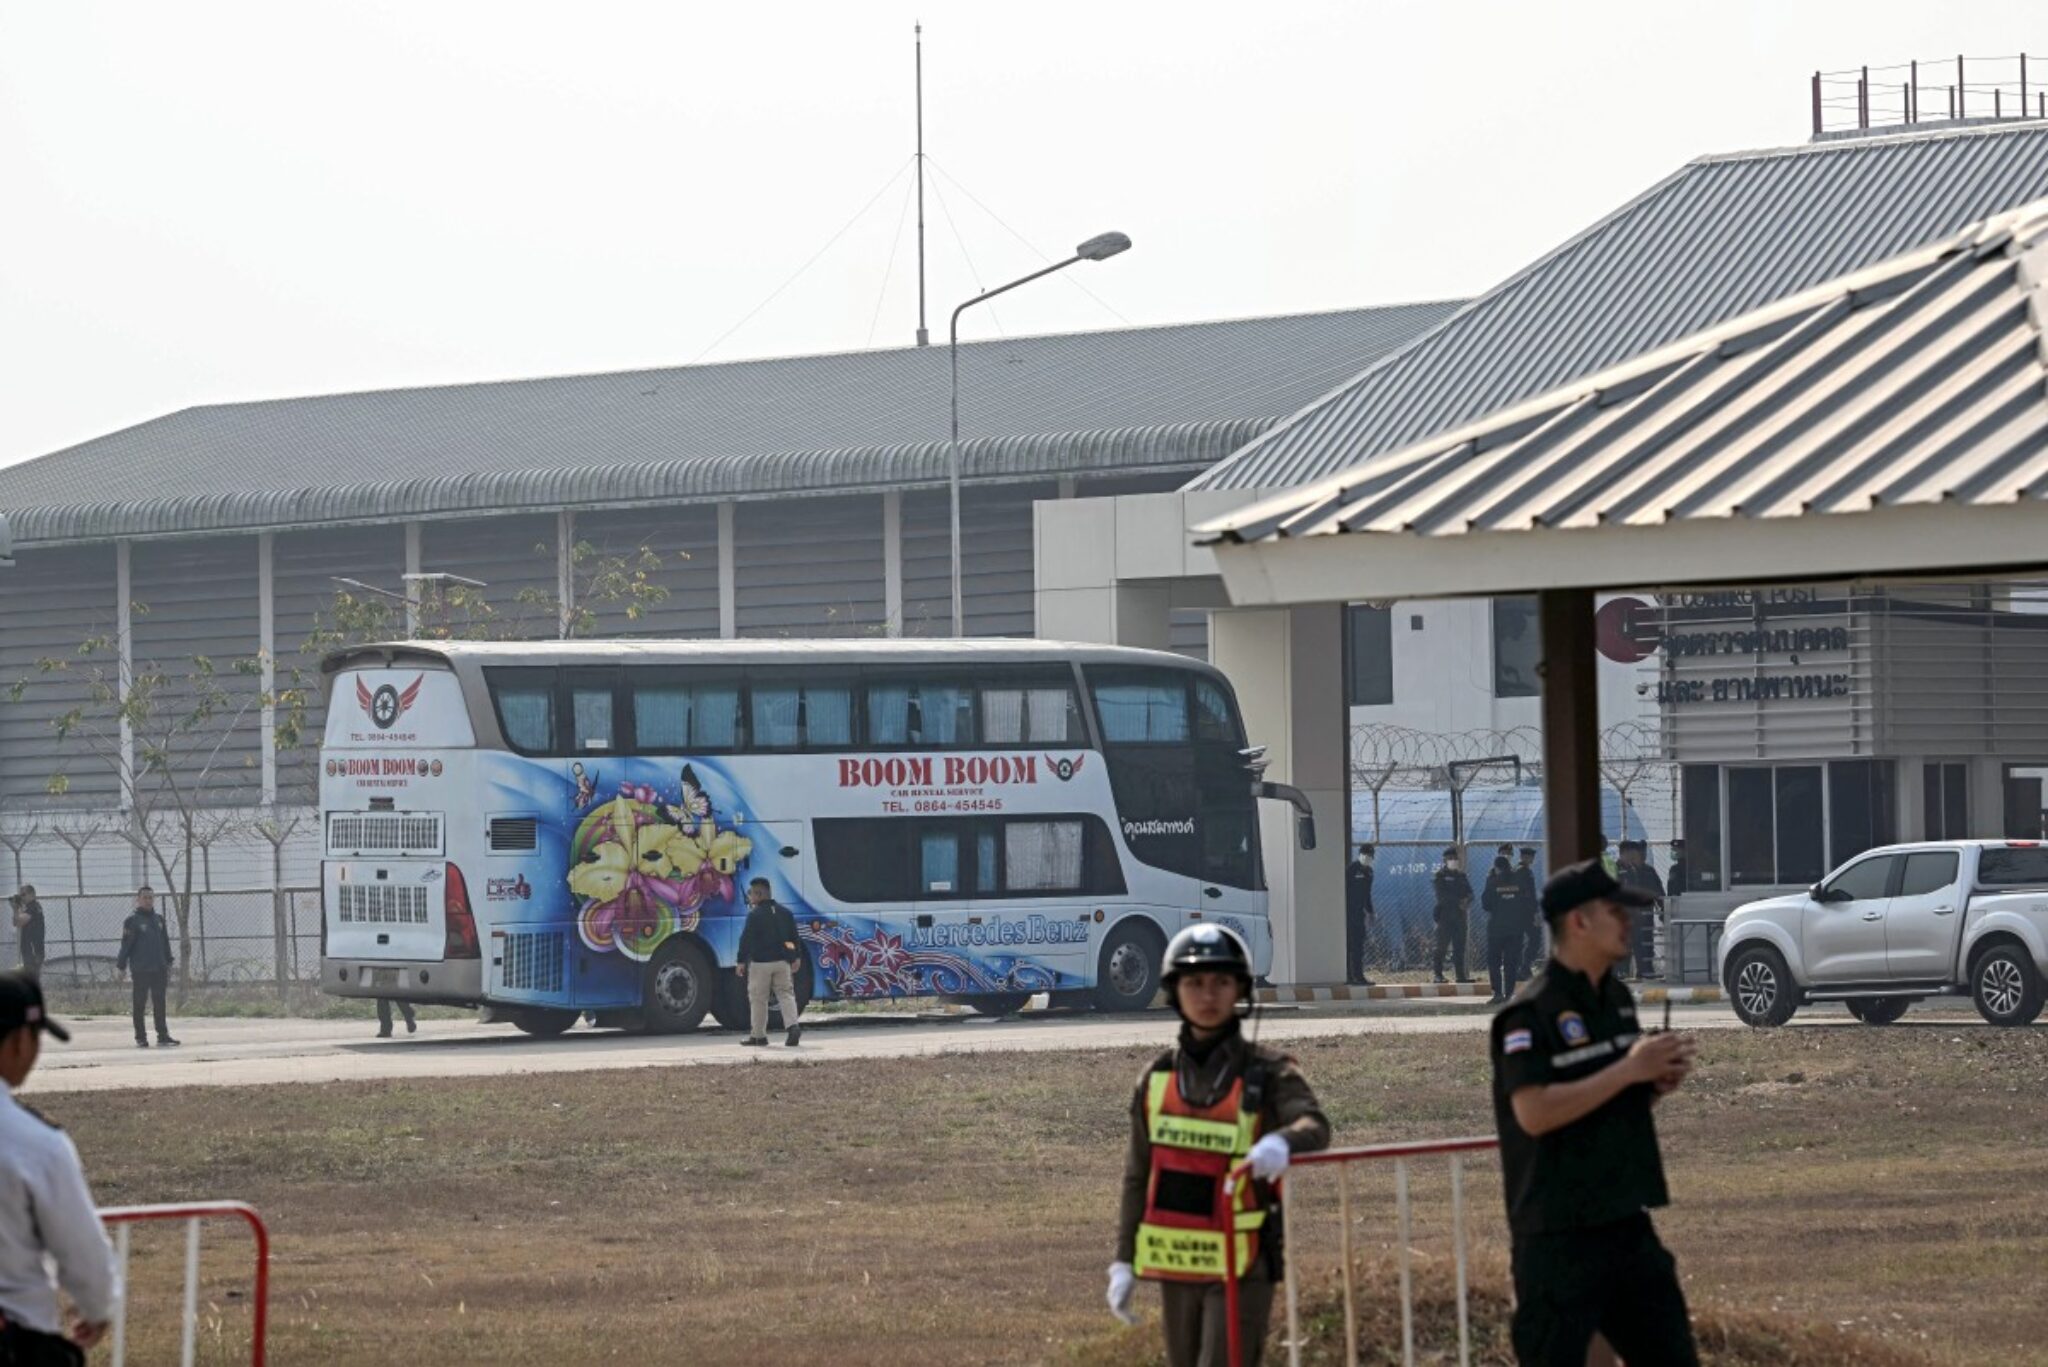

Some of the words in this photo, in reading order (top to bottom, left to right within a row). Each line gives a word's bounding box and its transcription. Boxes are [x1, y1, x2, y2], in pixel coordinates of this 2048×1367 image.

[1658, 680, 1704, 704] และ
[1712, 674, 1848, 702] ยานพาหนะ
[348, 759, 379, 775] BOOM
[383, 759, 416, 775] BOOM
[838, 758, 933, 787] BOOM
[944, 756, 1038, 785] BOOM
[911, 789, 945, 797] RENTAL
[947, 788, 984, 796] SERVICE
[882, 801, 909, 813] TEL.
[914, 799, 1002, 812] 0864-454545
